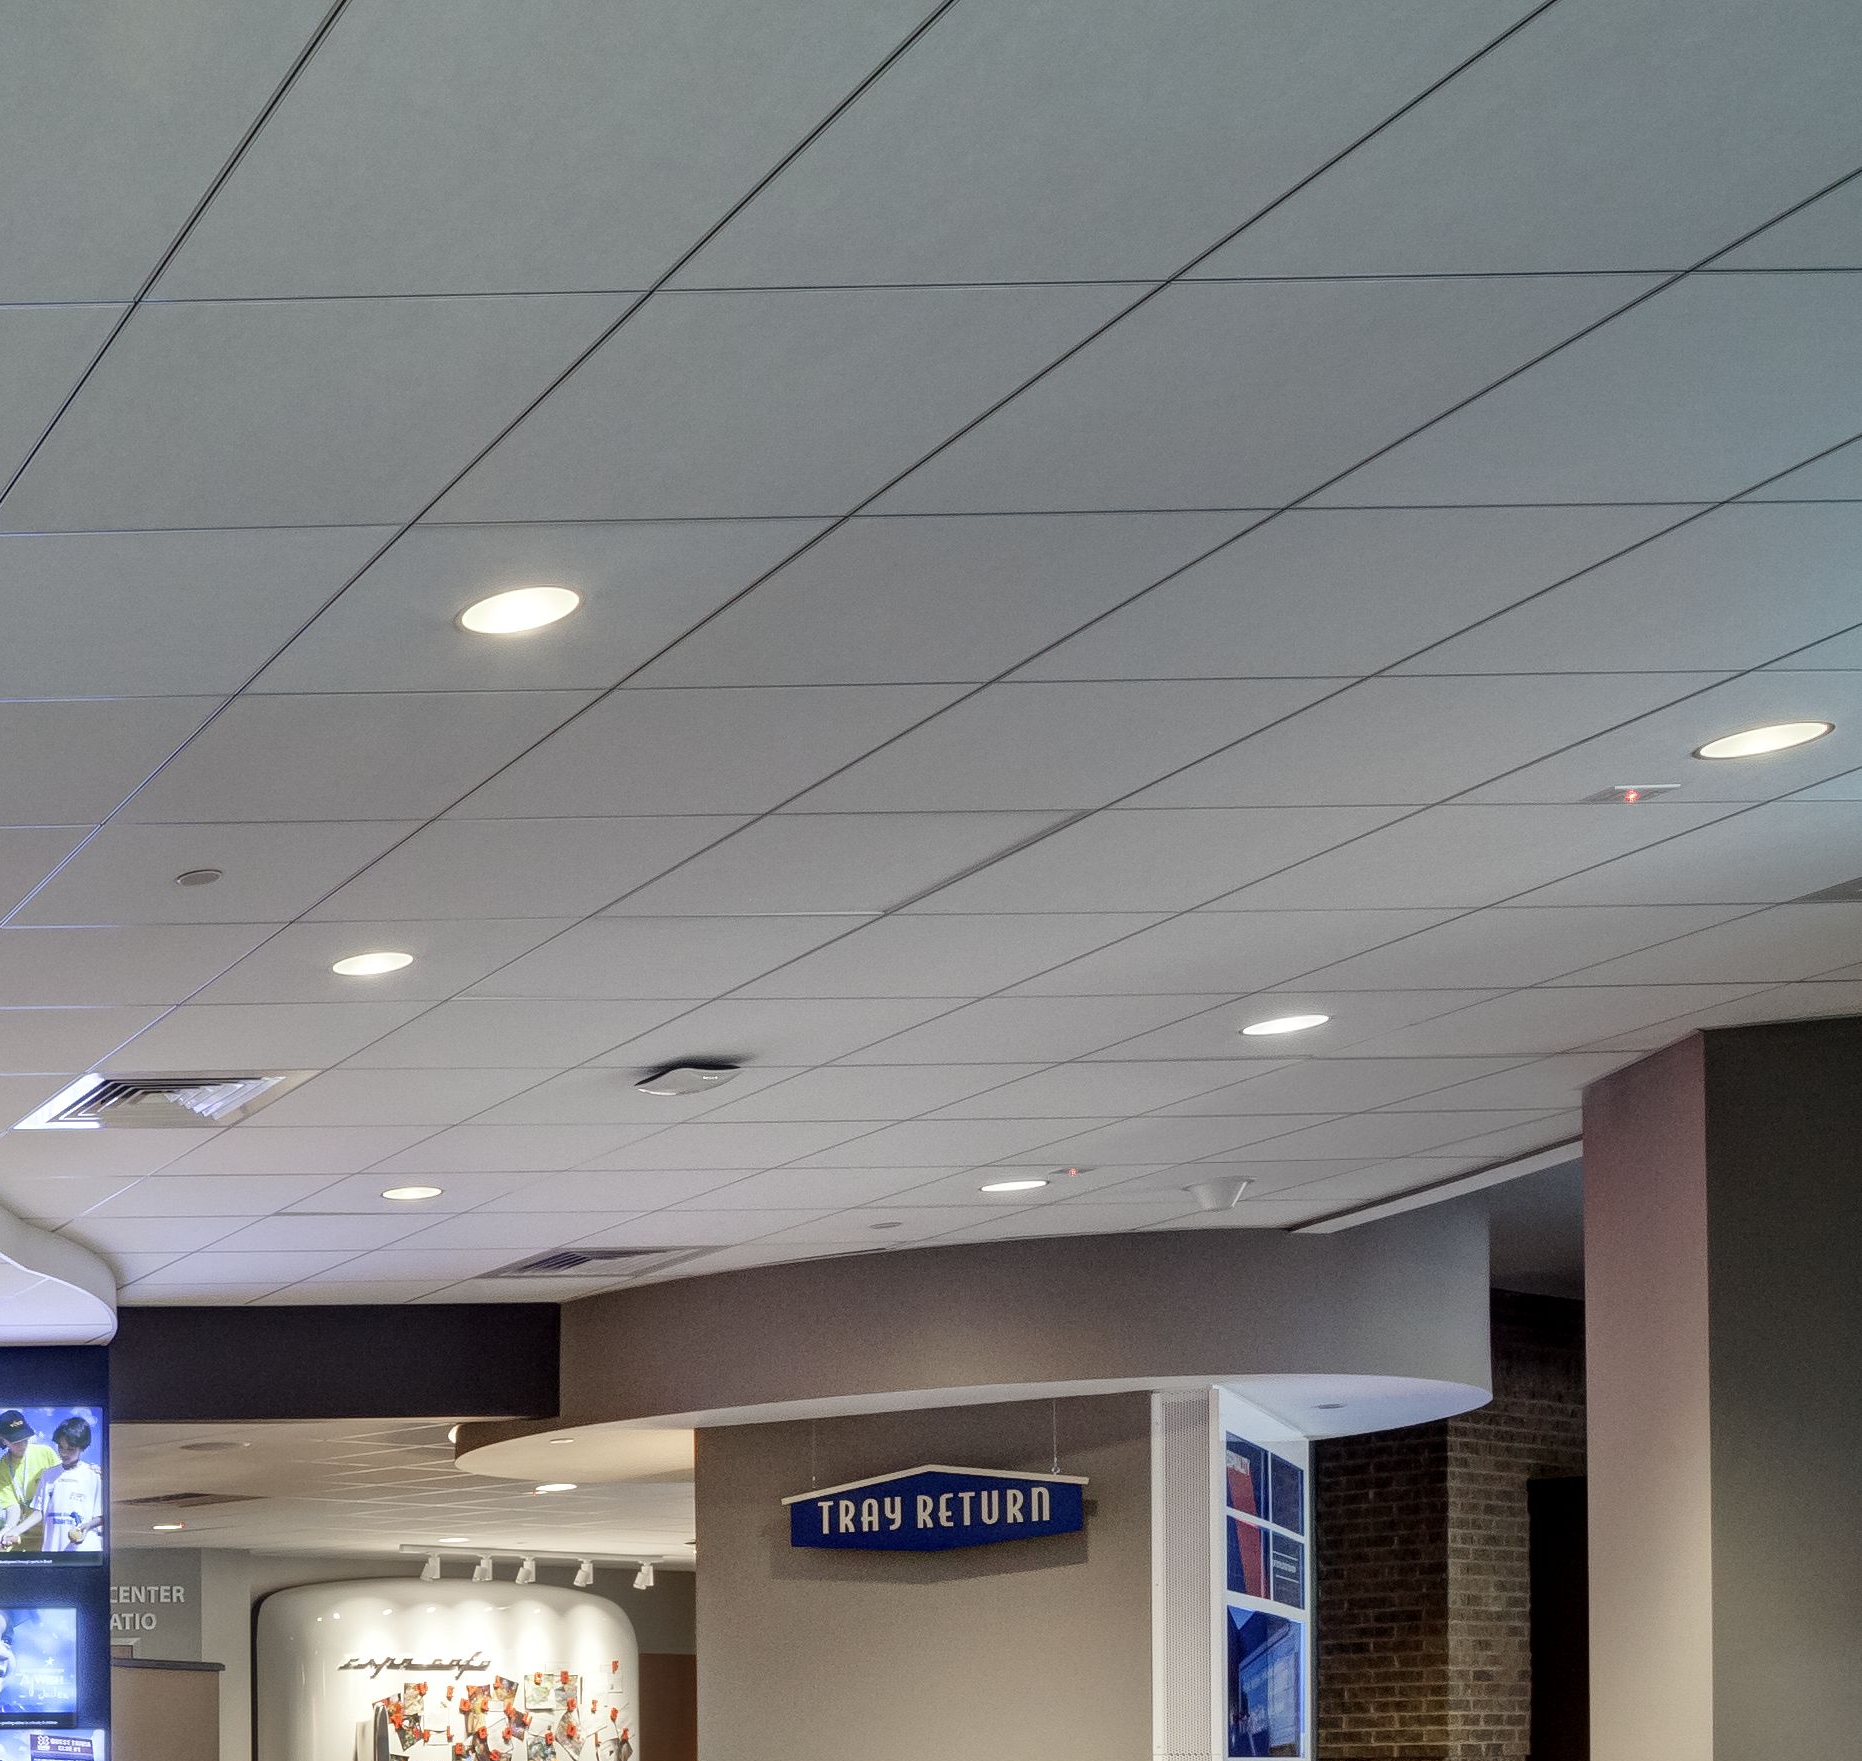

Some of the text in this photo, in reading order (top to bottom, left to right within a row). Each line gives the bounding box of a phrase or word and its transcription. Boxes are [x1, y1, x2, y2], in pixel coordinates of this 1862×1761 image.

[817, 1486, 1050, 1535] TRAY RETURN
[110, 1612, 156, 1631] ATIO
